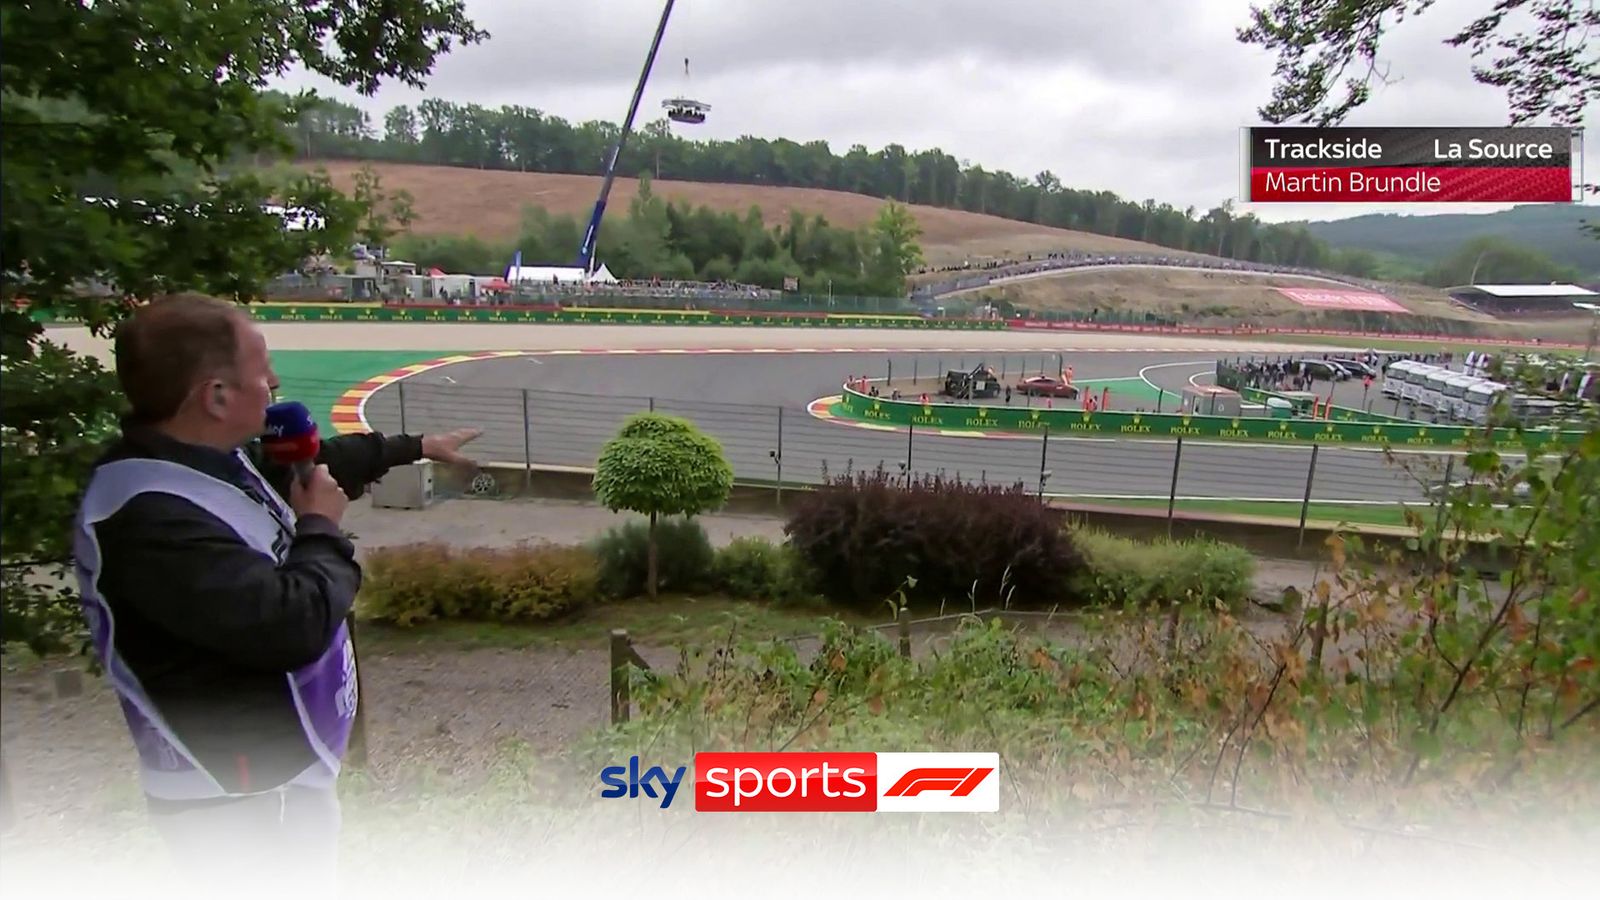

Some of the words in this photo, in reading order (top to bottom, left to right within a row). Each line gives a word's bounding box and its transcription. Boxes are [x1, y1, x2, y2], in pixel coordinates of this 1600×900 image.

[864, 409, 891, 420] ROLEX
[912, 415, 944, 425] ROLEX
[966, 418, 998, 427] ROLEX
[1071, 423, 1101, 431] ROLEX
[1120, 424, 1151, 433] ROLEX
[1170, 427, 1201, 435] ROLEX
[1220, 429, 1249, 438] ROLEX
[1268, 431, 1297, 440] ROLEX
[1314, 433, 1344, 442] ROLEX
[1361, 435, 1390, 443] ROLEX
